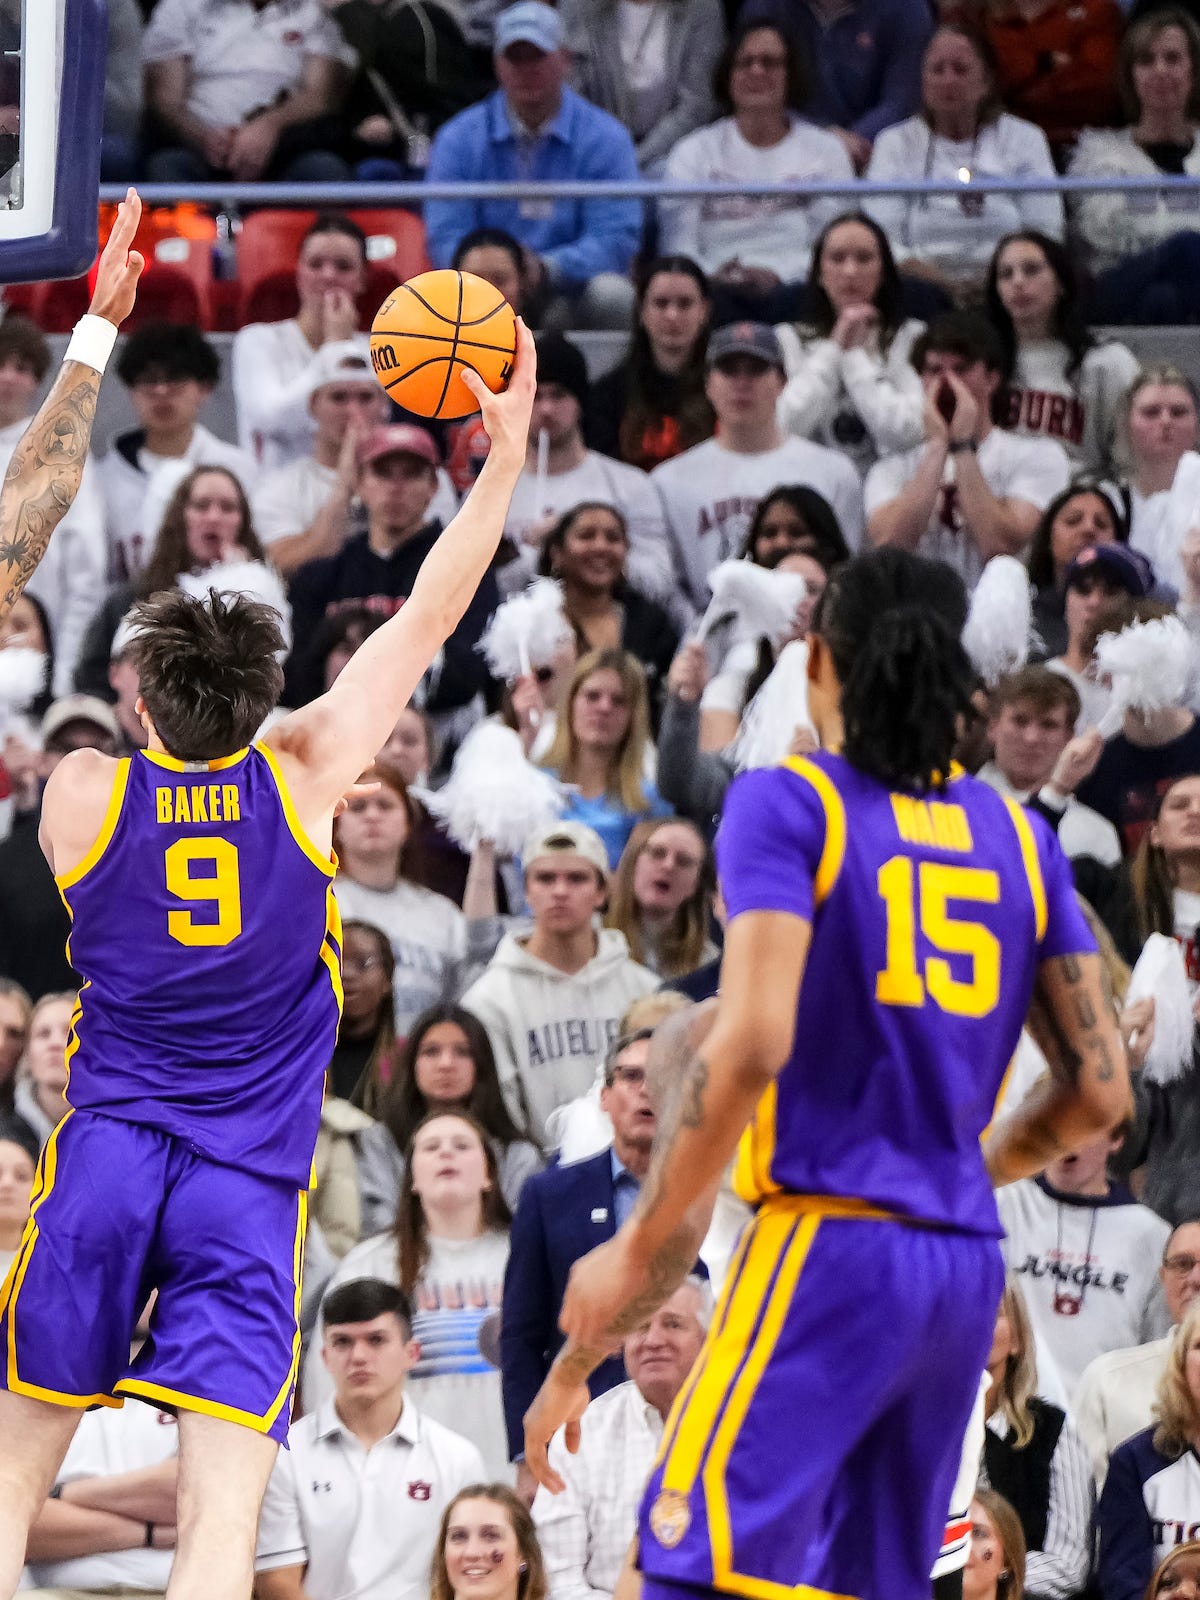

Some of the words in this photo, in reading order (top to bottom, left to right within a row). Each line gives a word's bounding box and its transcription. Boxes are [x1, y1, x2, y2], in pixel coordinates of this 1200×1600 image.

[155, 784, 241, 824] BAKER
[165, 837, 242, 947] 9
[875, 855, 1002, 1019] 15
